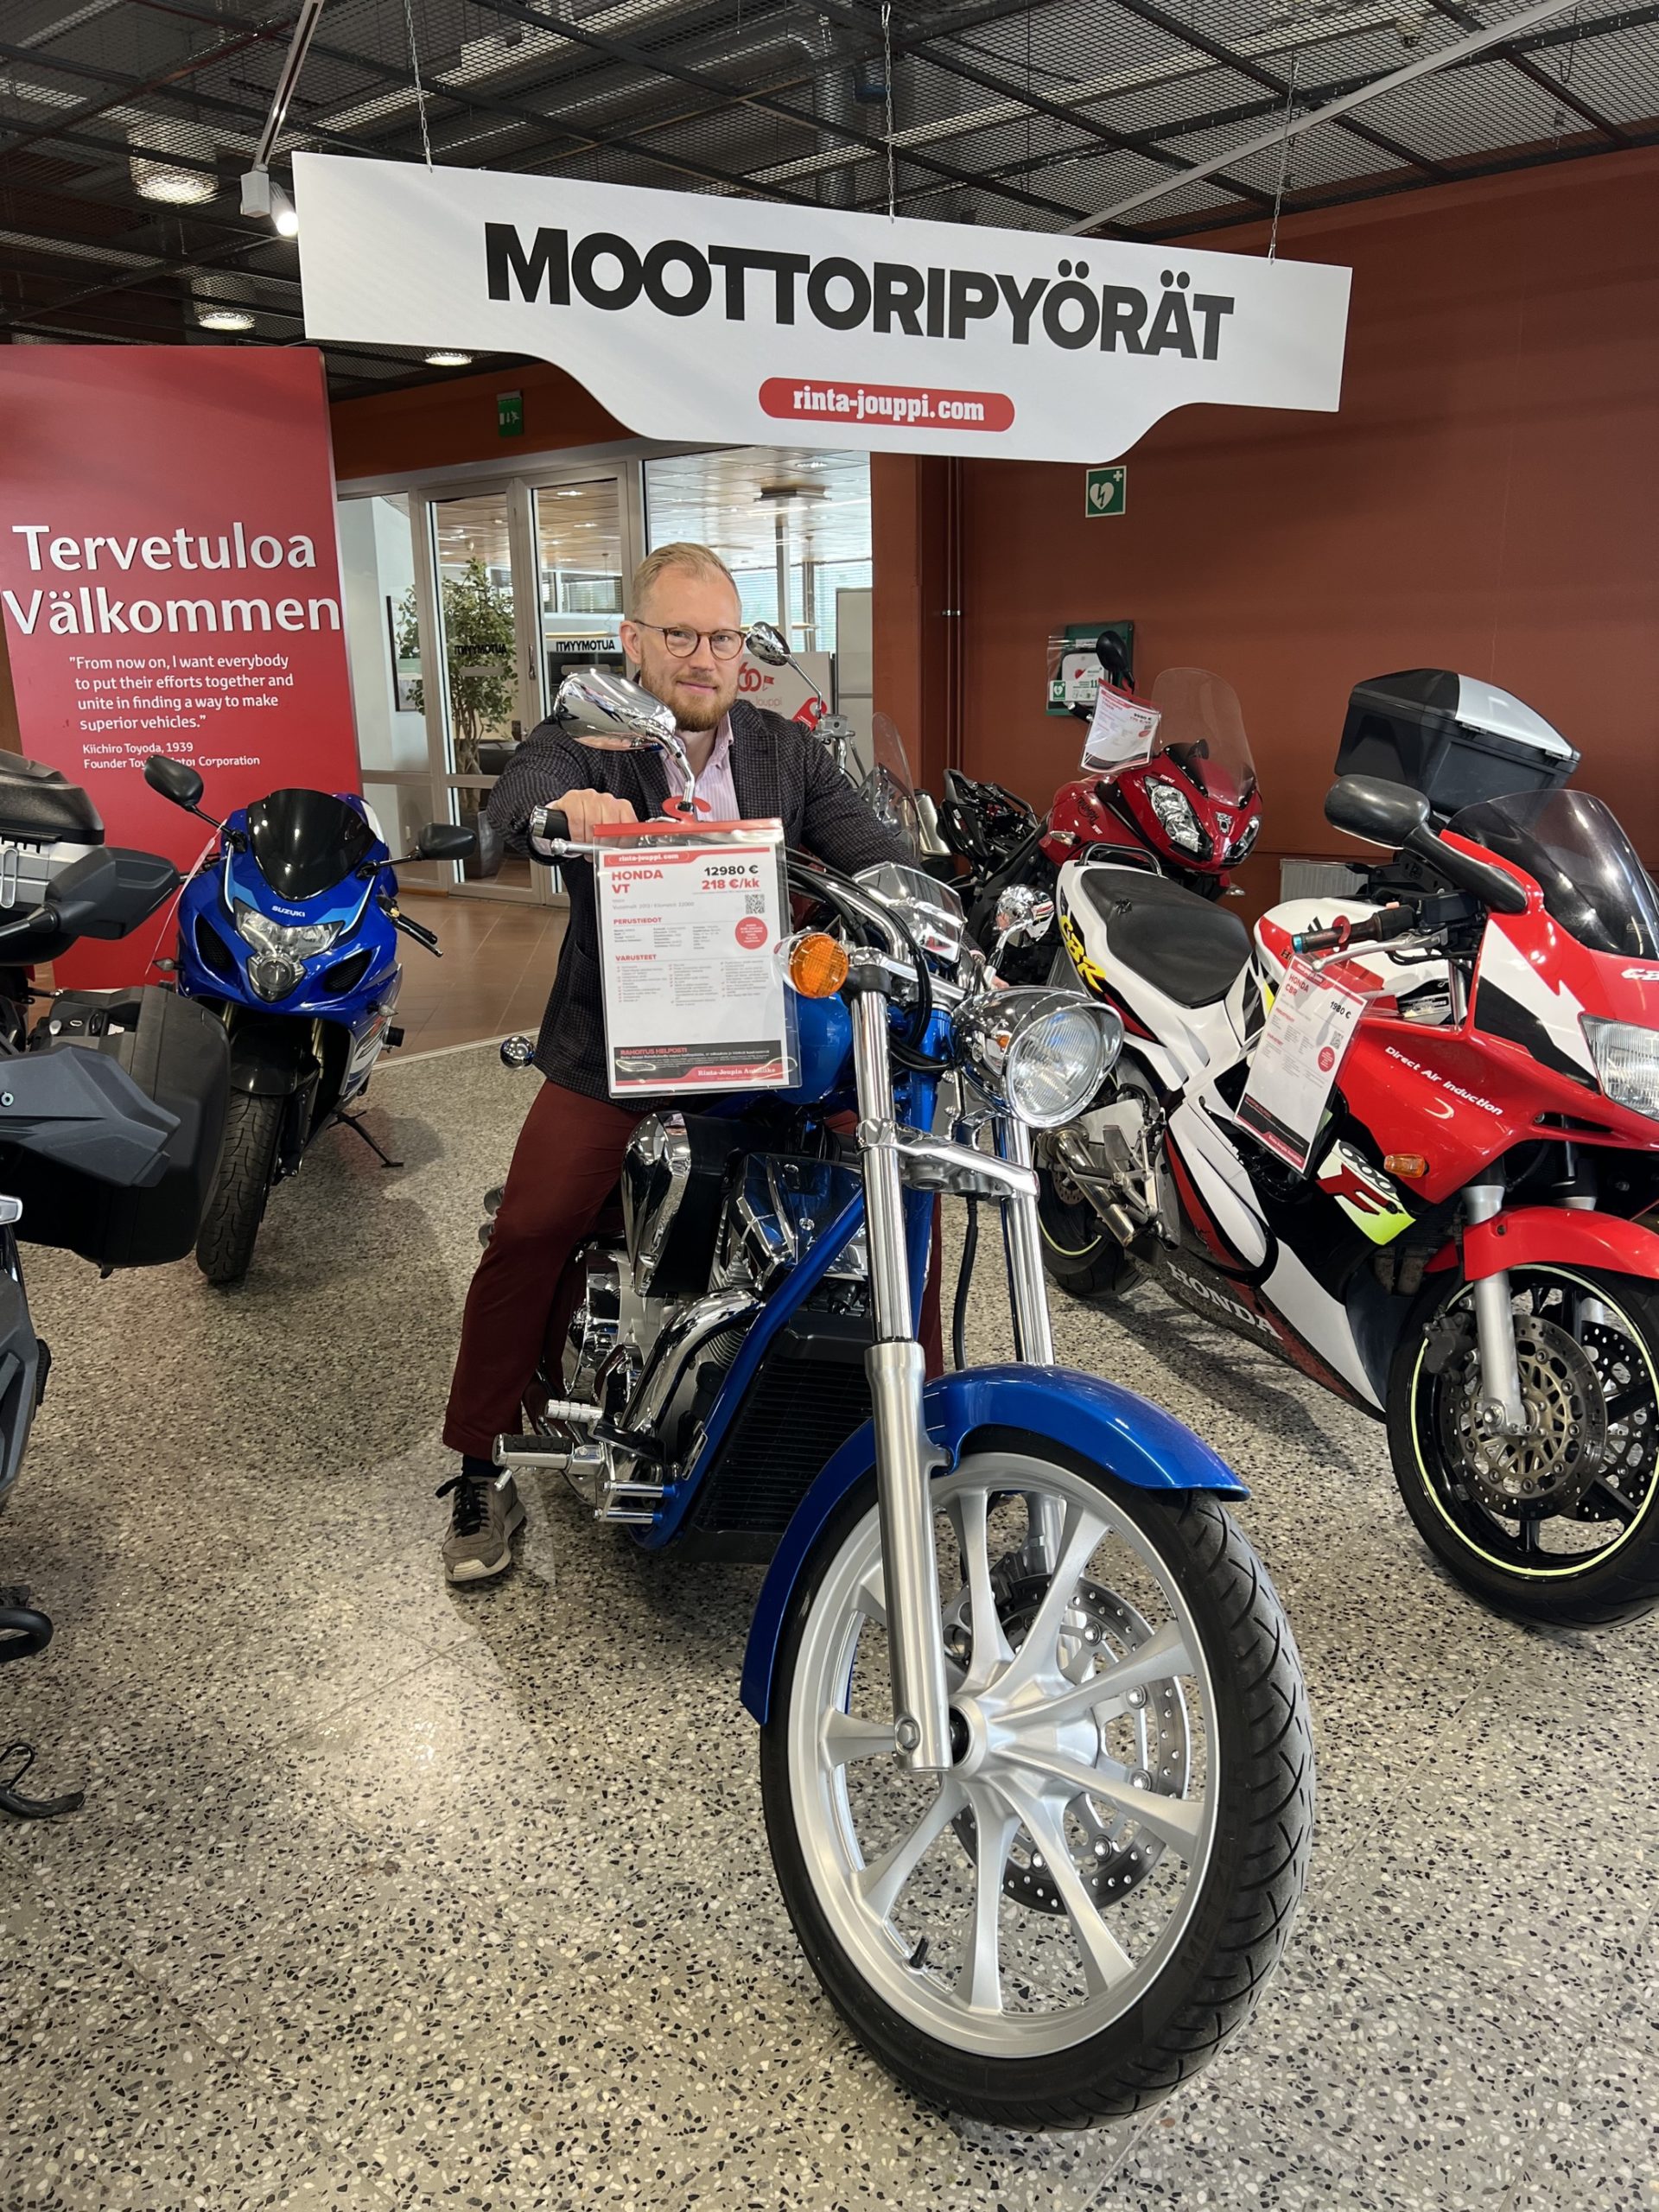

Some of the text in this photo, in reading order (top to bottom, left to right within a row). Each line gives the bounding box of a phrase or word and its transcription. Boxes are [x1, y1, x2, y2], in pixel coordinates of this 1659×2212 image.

[485, 222, 1235, 360] MOOTTORIPYÖRÄT
[793, 385, 985, 423] rinta-jouppi.com
[11, 522, 316, 570] Tervetuloa
[3, 587, 341, 634] Välkommen
[116, 658, 145, 670] now
[149, 658, 170, 671] on,
[172, 655, 177, 668] I
[179, 656, 214, 669] want
[217, 653, 289, 671] everybody
[74, 673, 294, 693] to put their efforts together and
[78, 693, 279, 712] unite in finding a way to make
[79, 715, 138, 733] superior
[83, 741, 194, 756] Kiichiro Toyoda, 1939
[84, 758, 127, 769] Founder
[198, 755, 260, 767] Corporation
[611, 864, 760, 881] HONDA 12980 €
[612, 877, 760, 894] VT 218 €/kk
[271, 905, 306, 918] SUZUKI
[615, 953, 657, 962] VARUSTEET
[1059, 914, 1107, 993] CBR
[1331, 1001, 1345, 1016] 1980
[1384, 1046, 1503, 1116] Direct Air Induction
[1338, 1141, 1398, 1194] 600
[1166, 1260, 1285, 1341] HONDA
